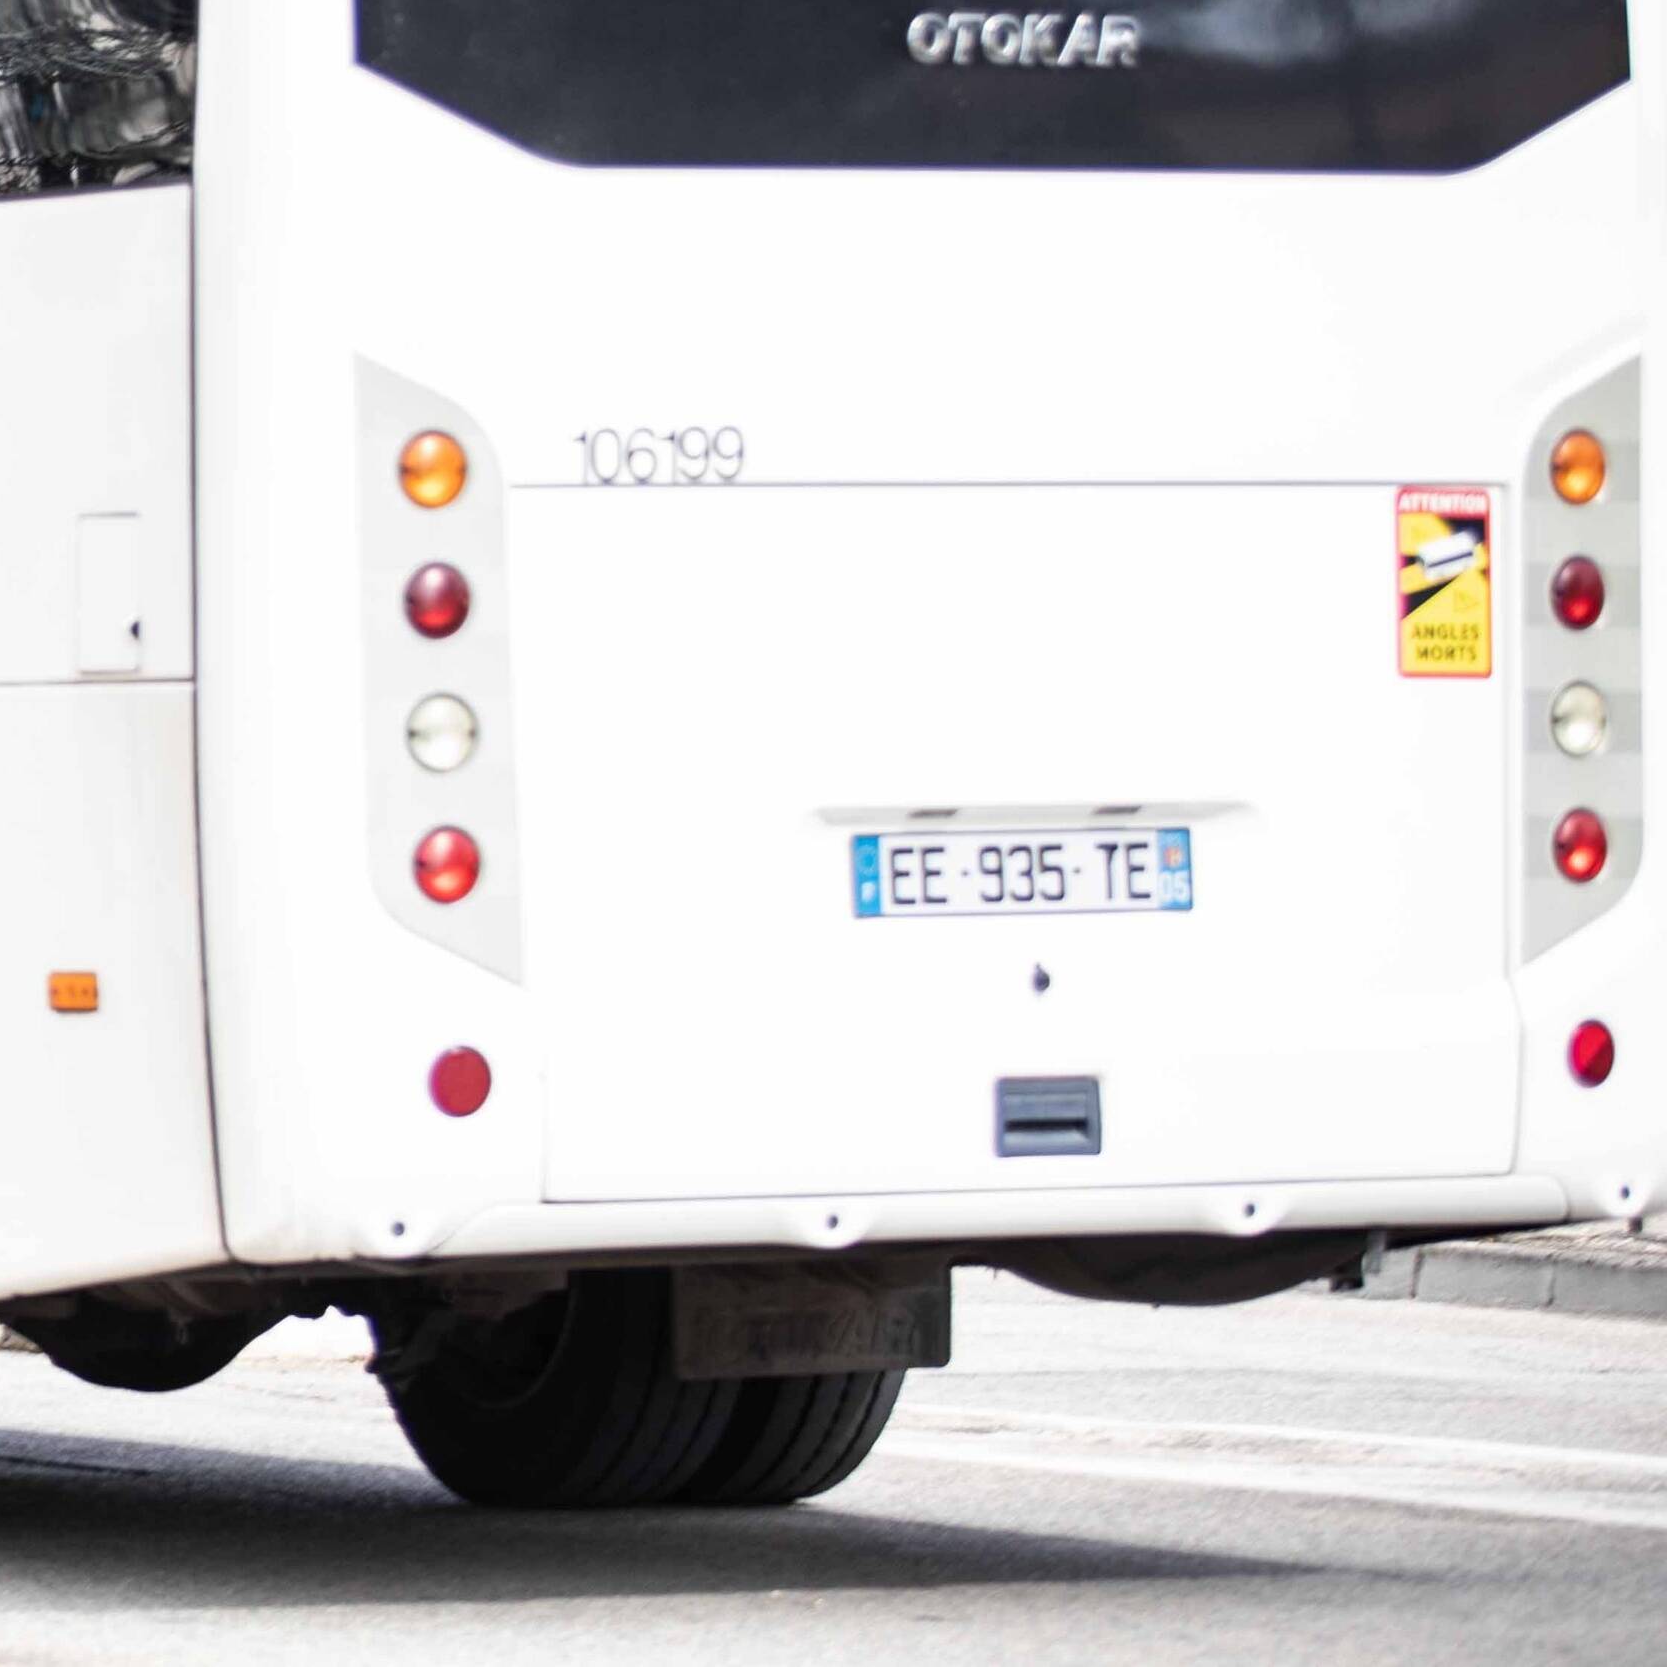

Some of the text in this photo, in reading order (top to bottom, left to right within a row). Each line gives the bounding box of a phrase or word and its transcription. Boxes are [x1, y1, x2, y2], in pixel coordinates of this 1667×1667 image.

[907, 12, 1139, 67] OTOKAR
[573, 425, 744, 485] 106199
[1411, 623, 1480, 641] ANGLES
[1416, 644, 1478, 662] MORTS
